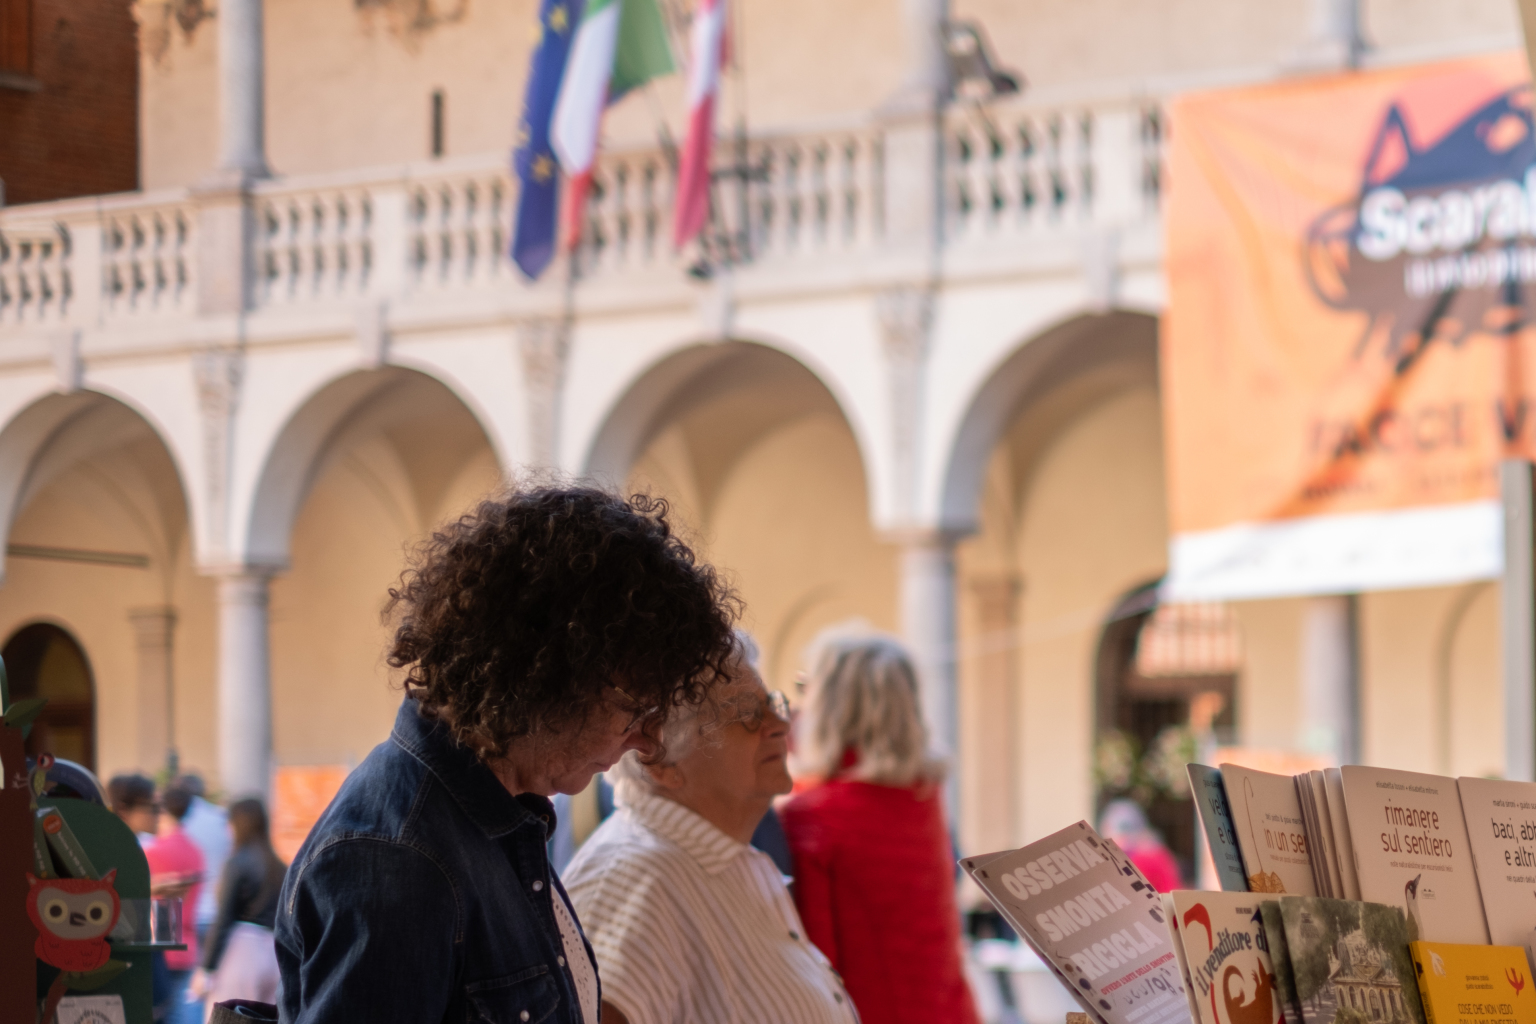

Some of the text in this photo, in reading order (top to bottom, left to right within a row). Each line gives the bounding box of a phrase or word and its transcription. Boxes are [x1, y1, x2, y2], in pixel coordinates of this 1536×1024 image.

[1384, 798, 1440, 830] rimanere
[1490, 817, 1519, 844] baci,
[1380, 827, 1453, 858] sul sentiero
[1504, 849, 1512, 866] e
[1514, 845, 1536, 868] altri
[1001, 839, 1105, 900] OSSERVA
[1036, 881, 1131, 942] SMONTA
[1070, 921, 1164, 981] RICICLA
[1195, 966, 1210, 997] il
[1203, 927, 1252, 981] venditore
[1100, 952, 1175, 996] OVVERO L'ARTE DELLO SMONTING
[1458, 1003, 1513, 1015] COSE CHE NON VEDO
